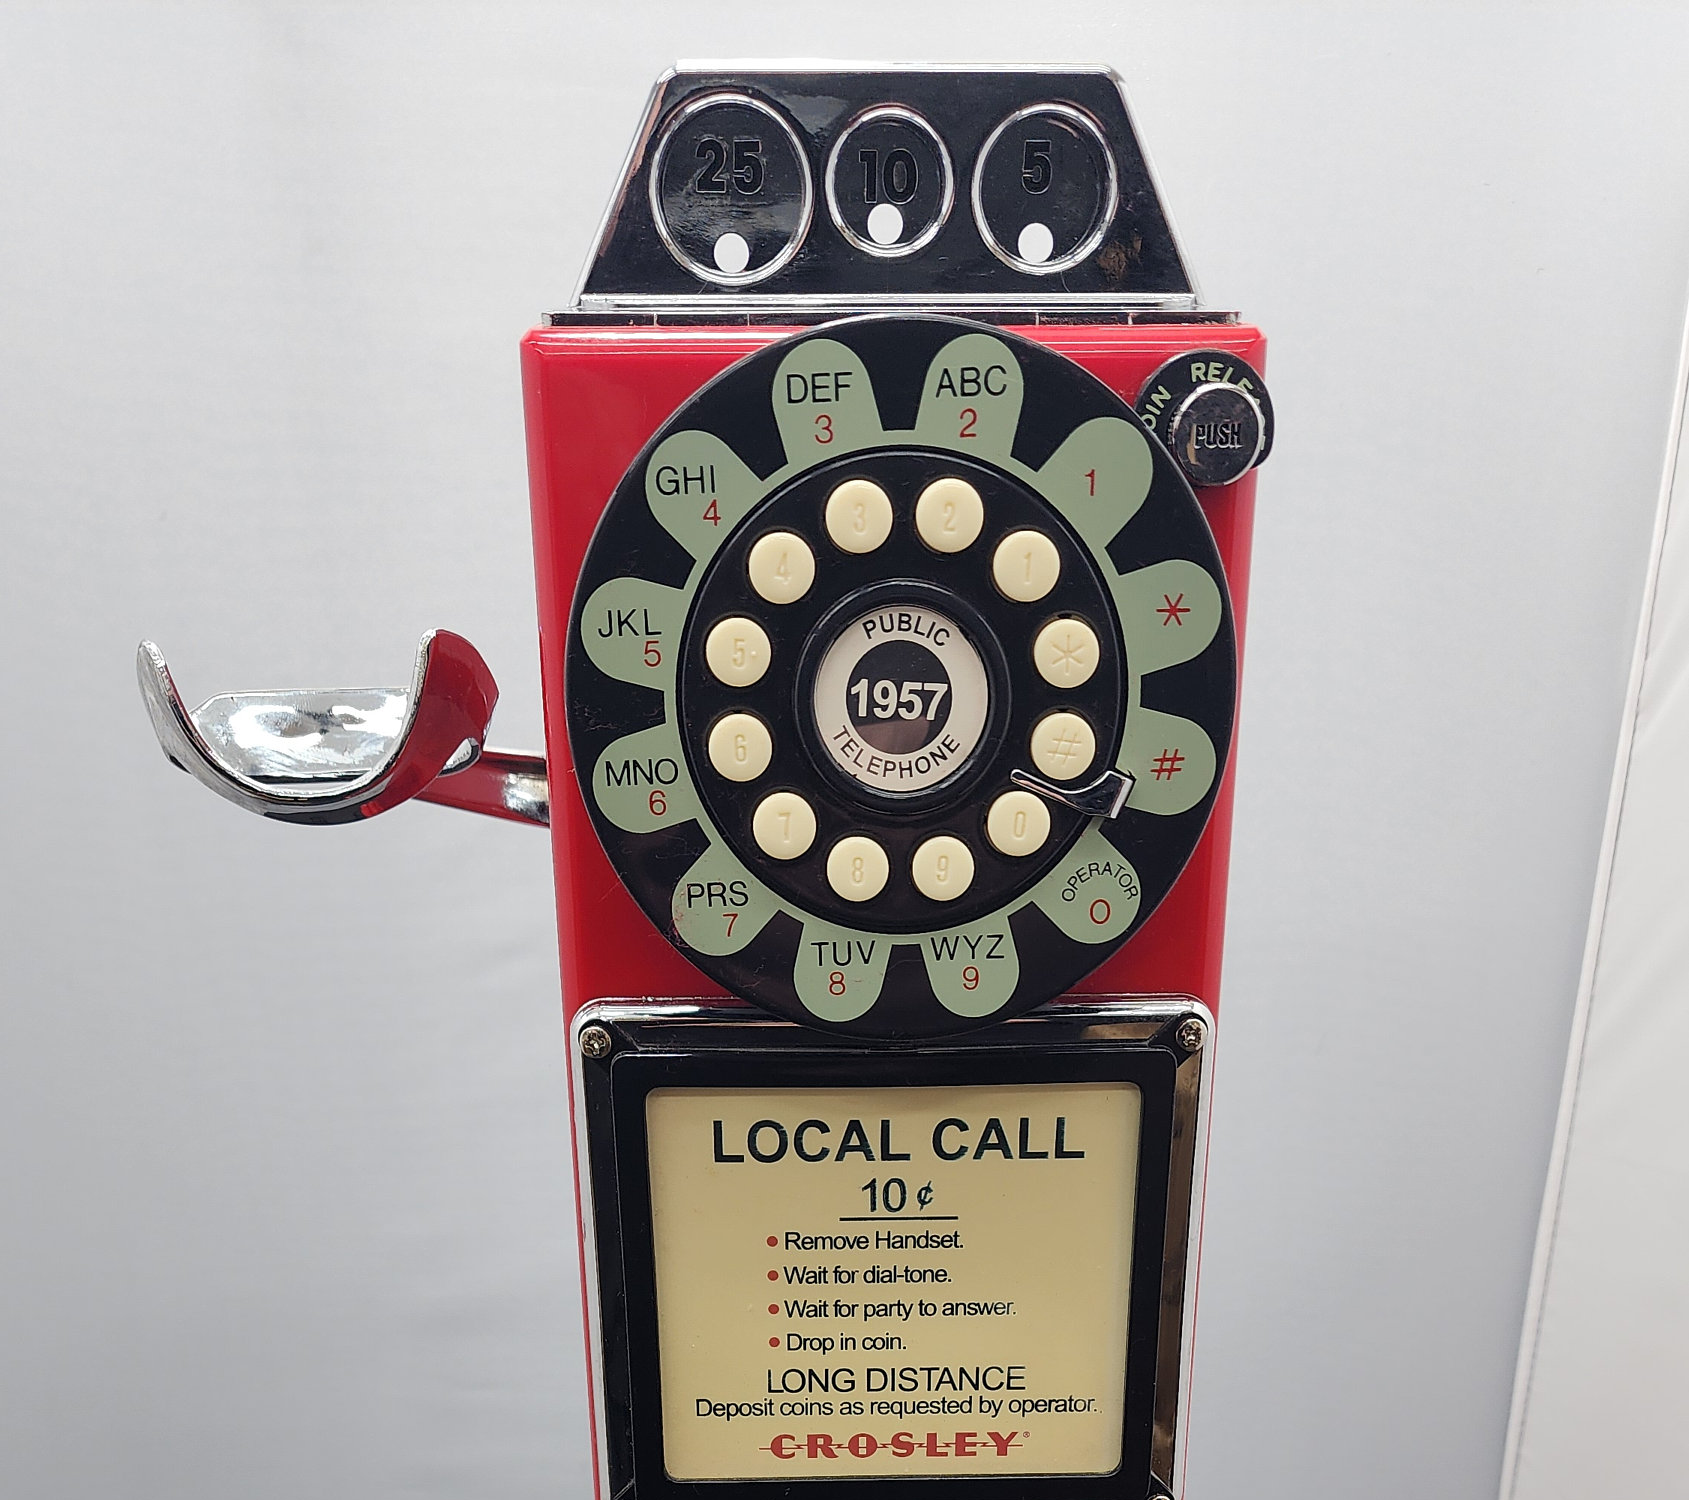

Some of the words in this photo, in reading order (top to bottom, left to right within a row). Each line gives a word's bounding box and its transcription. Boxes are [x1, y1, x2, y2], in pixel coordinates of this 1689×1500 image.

[696, 137, 766, 196] 25
[858, 148, 920, 205] 10
[1020, 138, 1053, 195] 5
[786, 371, 853, 404] DEF
[935, 364, 1007, 398] ABC
[1138, 384, 1172, 431] OIN
[814, 413, 835, 445] 3
[959, 407, 978, 439] 2
[1193, 421, 1243, 450] PUSH
[655, 464, 716, 496] GHI
[1085, 469, 1096, 496] 1
[703, 499, 721, 526] 4
[852, 503, 868, 535] 3
[942, 501, 958, 535] 2
[773, 550, 792, 585] 4
[1024, 550, 1034, 585] 1
[597, 608, 662, 638] JKL
[862, 613, 951, 647] PUBLIC
[643, 639, 662, 668] 5
[850, 678, 949, 721] 1957
[733, 733, 748, 763] 6
[833, 725, 961, 779] TELEPHONE
[605, 758, 679, 787] MNO
[648, 789, 667, 817] 6
[777, 811, 792, 843] 7
[851, 856, 864, 883] 8
[935, 854, 950, 882] 9
[1060, 861, 1139, 903] OPERATOR
[686, 881, 749, 909] PRS
[722, 912, 739, 938] 7
[810, 940, 876, 967] TUV
[930, 934, 1005, 962] WYZ
[828, 970, 847, 997] 8
[962, 965, 980, 991] 9
[712, 1119, 911, 1164] LOCAL
[931, 1116, 1085, 1161] CALL
[861, 1177, 907, 1213] 10
[784, 1231, 870, 1251] Remove
[875, 1229, 964, 1250] Handset.
[783, 1265, 829, 1285] Wait
[833, 1265, 860, 1284] for
[863, 1264, 952, 1284] dial-tone.
[784, 1299, 830, 1319] Wait
[833, 1299, 860, 1318] for
[863, 1299, 913, 1322] party
[917, 1299, 938, 1317] to
[941, 1301, 1017, 1317] answer.
[786, 1333, 835, 1356] Drop
[840, 1332, 857, 1351] in
[861, 1332, 907, 1351] coin.
[767, 1367, 856, 1394] LONG
[866, 1365, 1026, 1393] DISTANCE
[695, 1397, 775, 1422] Deposit
[780, 1397, 834, 1417] coins
[839, 1401, 865, 1416] as
[870, 1395, 973, 1420] requested
[979, 1395, 1004, 1419] by
[1008, 1394, 1098, 1418] operator.
[768, 1431, 1018, 1460] CROSLEY
